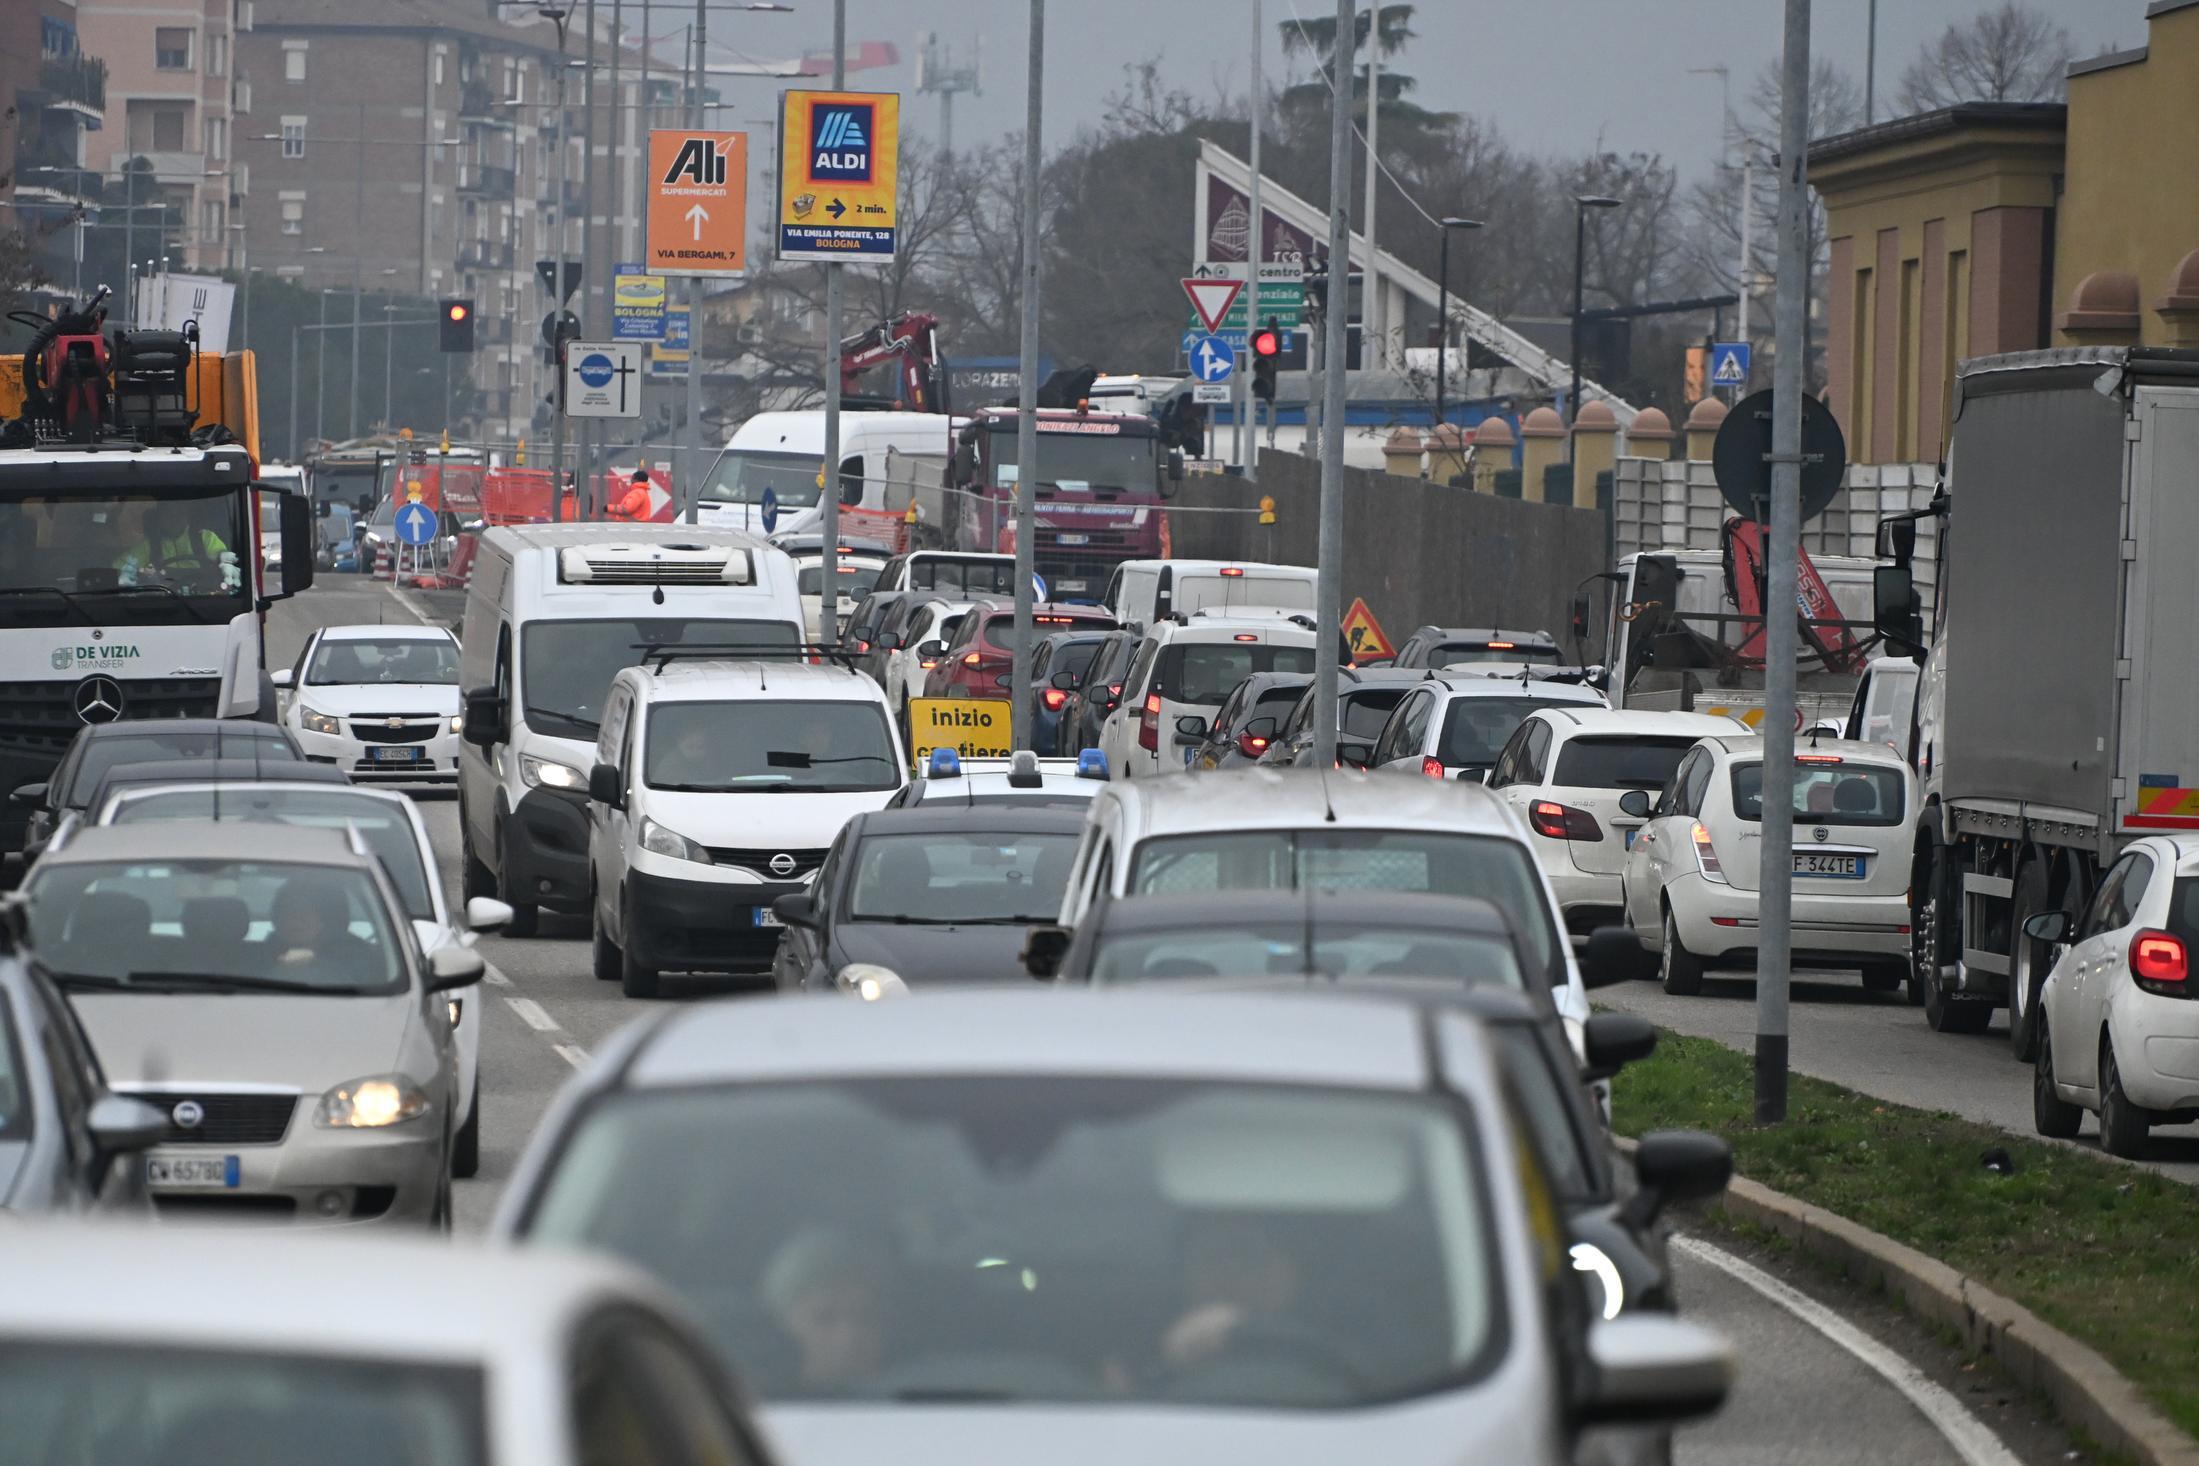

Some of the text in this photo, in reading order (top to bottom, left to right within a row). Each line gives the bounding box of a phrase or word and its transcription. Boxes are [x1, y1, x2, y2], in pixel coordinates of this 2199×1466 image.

[815, 153, 866, 170] ALDI
[661, 188, 727, 197] SUPERMERCATI
[856, 204, 887, 214] 2 min.
[787, 228, 802, 237] VIA
[803, 229, 832, 238] EMILIA
[875, 232, 890, 240] 128
[815, 239, 860, 248] BOLOGNA
[658, 249, 676, 258] VIA
[729, 251, 736, 260] 7
[1259, 266, 1301, 278] centro
[614, 308, 664, 317] BOLOGNA
[76, 645, 140, 659] DE VIZIA
[77, 659, 124, 670] TRANSFER
[931, 707, 992, 727] inizio
[916, 742, 1011, 757] ctiere
[1808, 856, 1855, 873] 344TE
